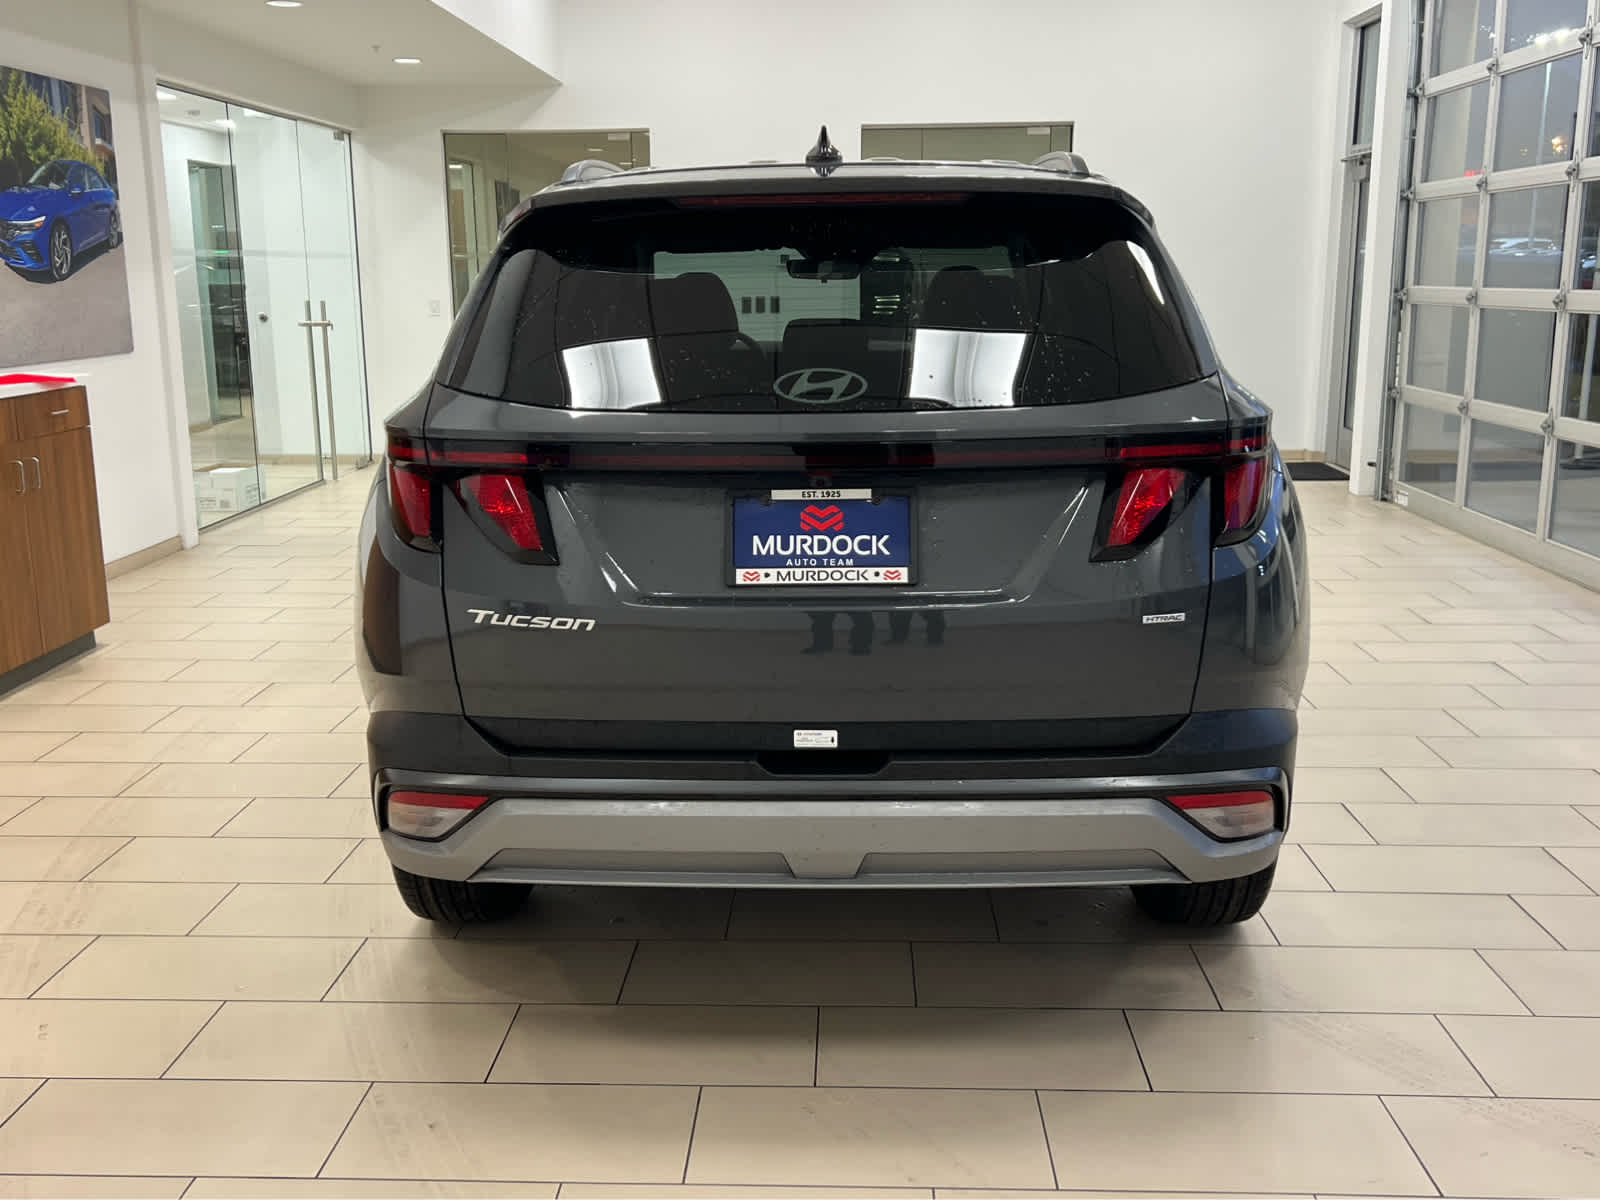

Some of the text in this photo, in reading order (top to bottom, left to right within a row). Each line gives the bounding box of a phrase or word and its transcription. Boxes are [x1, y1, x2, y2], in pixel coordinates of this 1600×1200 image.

[801, 490, 841, 498] EST. 1925
[752, 535, 890, 555] MURDOCK
[786, 558, 854, 566] AUTO TEAM
[776, 570, 869, 581] MURDOCK
